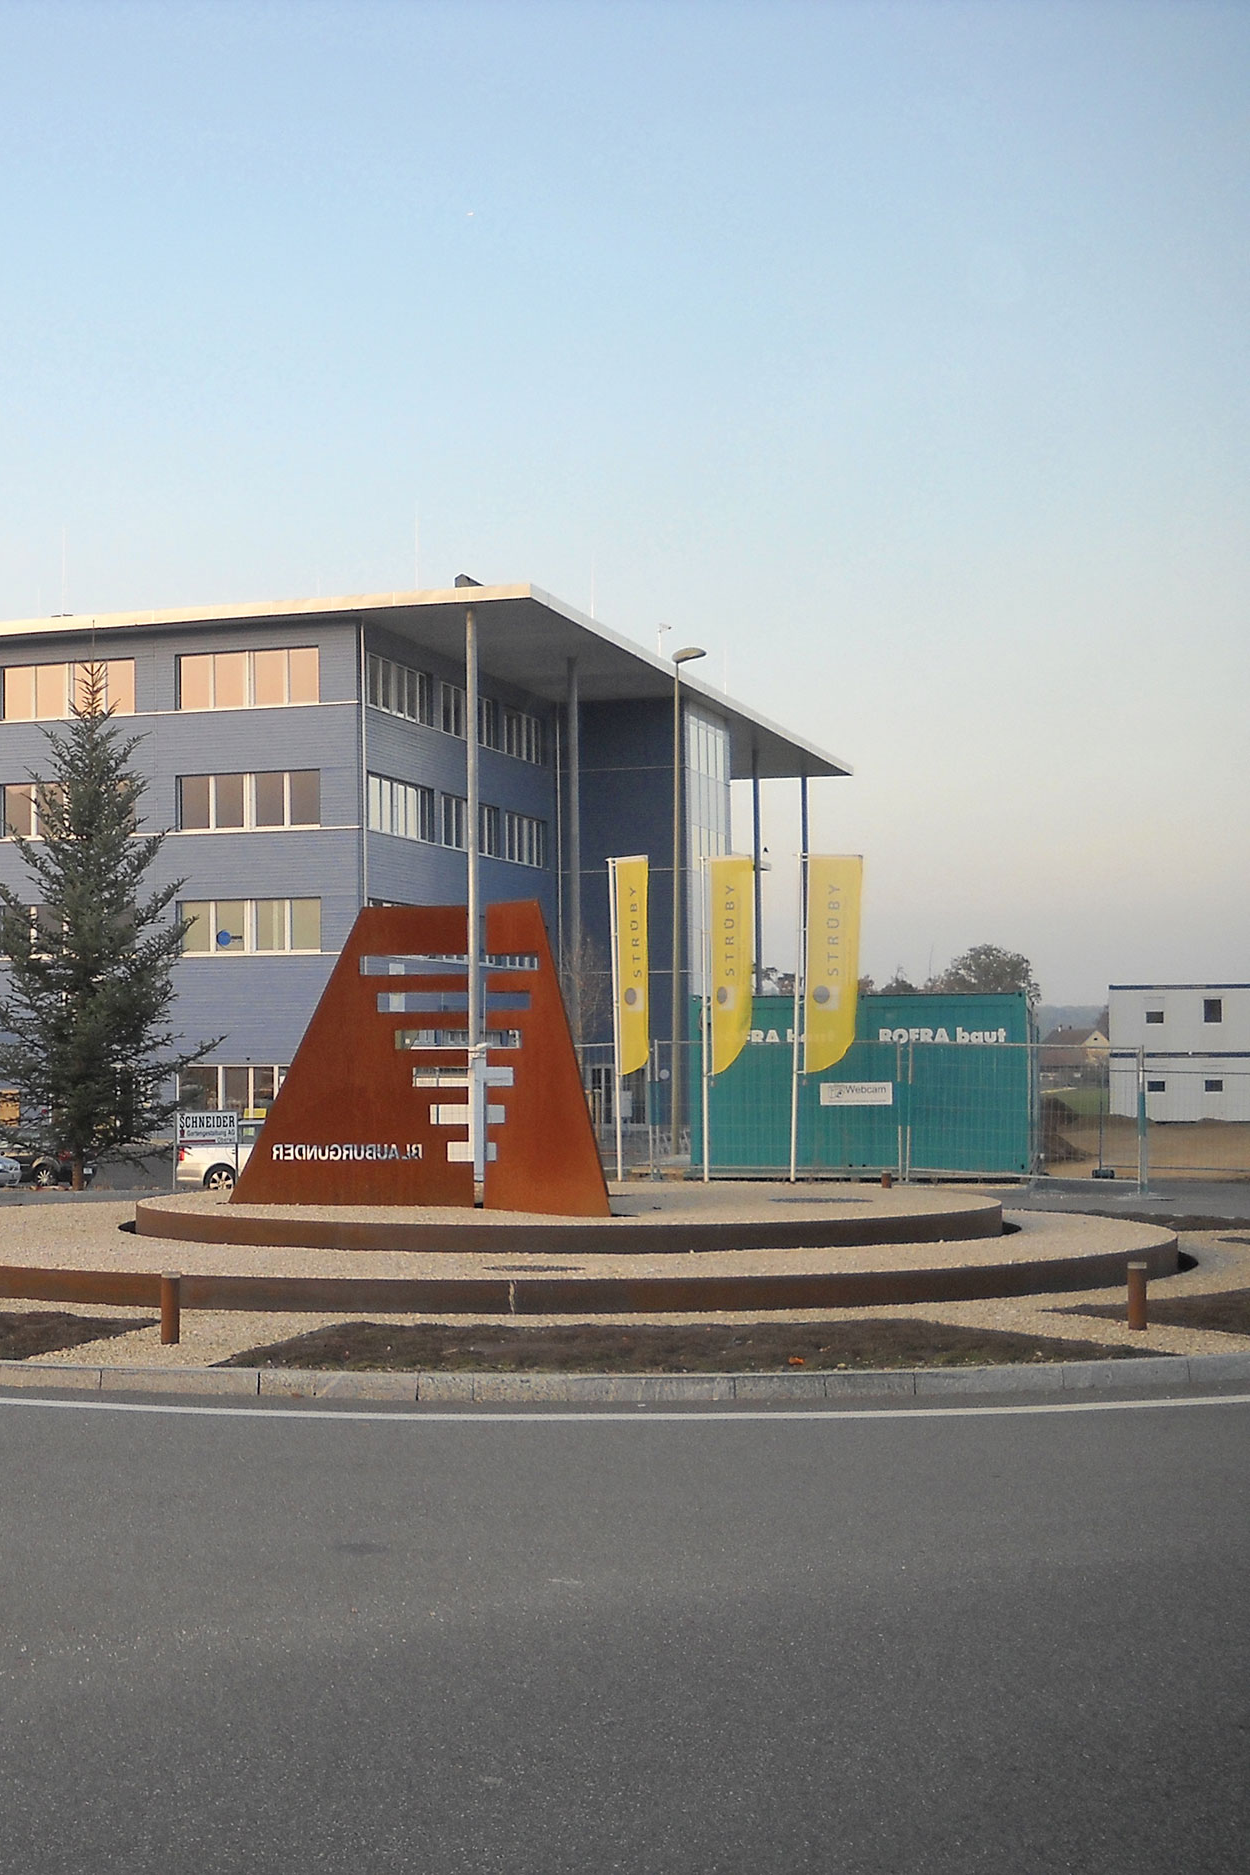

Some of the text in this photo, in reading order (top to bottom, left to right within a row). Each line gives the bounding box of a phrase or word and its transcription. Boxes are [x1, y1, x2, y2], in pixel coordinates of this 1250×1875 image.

[629, 887, 642, 978] STRÜBY
[725, 885, 735, 977] STRÜBY
[827, 884, 841, 977] STRÜBY
[879, 1027, 1006, 1043] ROFRA baut
[846, 1085, 887, 1094] Webcam
[179, 1113, 235, 1128] SCHNEIDER
